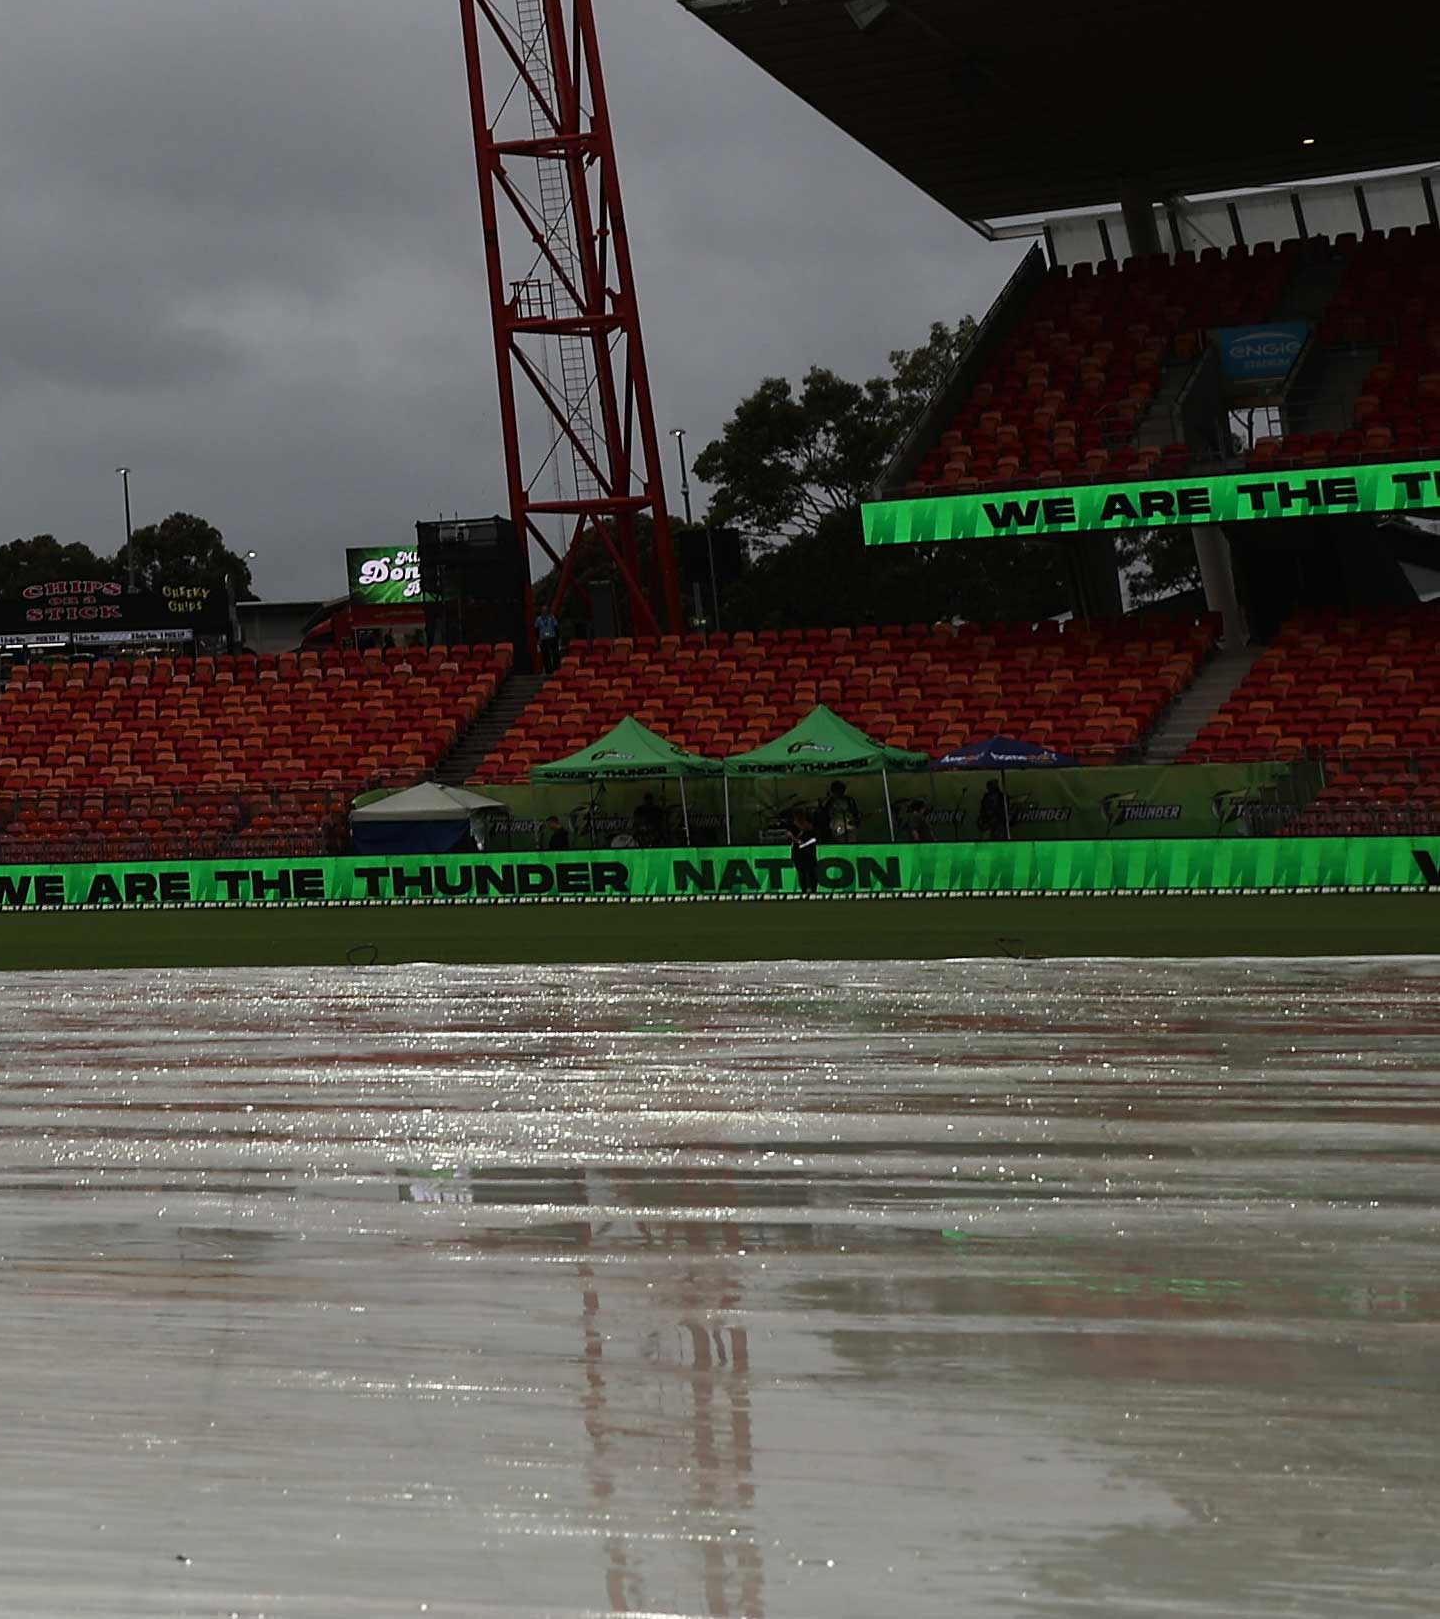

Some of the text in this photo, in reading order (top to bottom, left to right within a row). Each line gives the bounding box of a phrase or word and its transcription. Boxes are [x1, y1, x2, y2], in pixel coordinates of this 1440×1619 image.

[983, 497, 1076, 527] WE
[1102, 487, 1211, 521] ARE
[1237, 477, 1358, 511] THE
[359, 557, 421, 584] Don
[22, 580, 123, 600] CHIPS
[26, 605, 122, 621] STICK
[1123, 805, 1182, 820] THUNDER
[86, 871, 190, 903] ARE
[215, 868, 324, 899] THE
[355, 861, 629, 897] THUNDER
[673, 856, 902, 890] NATON
